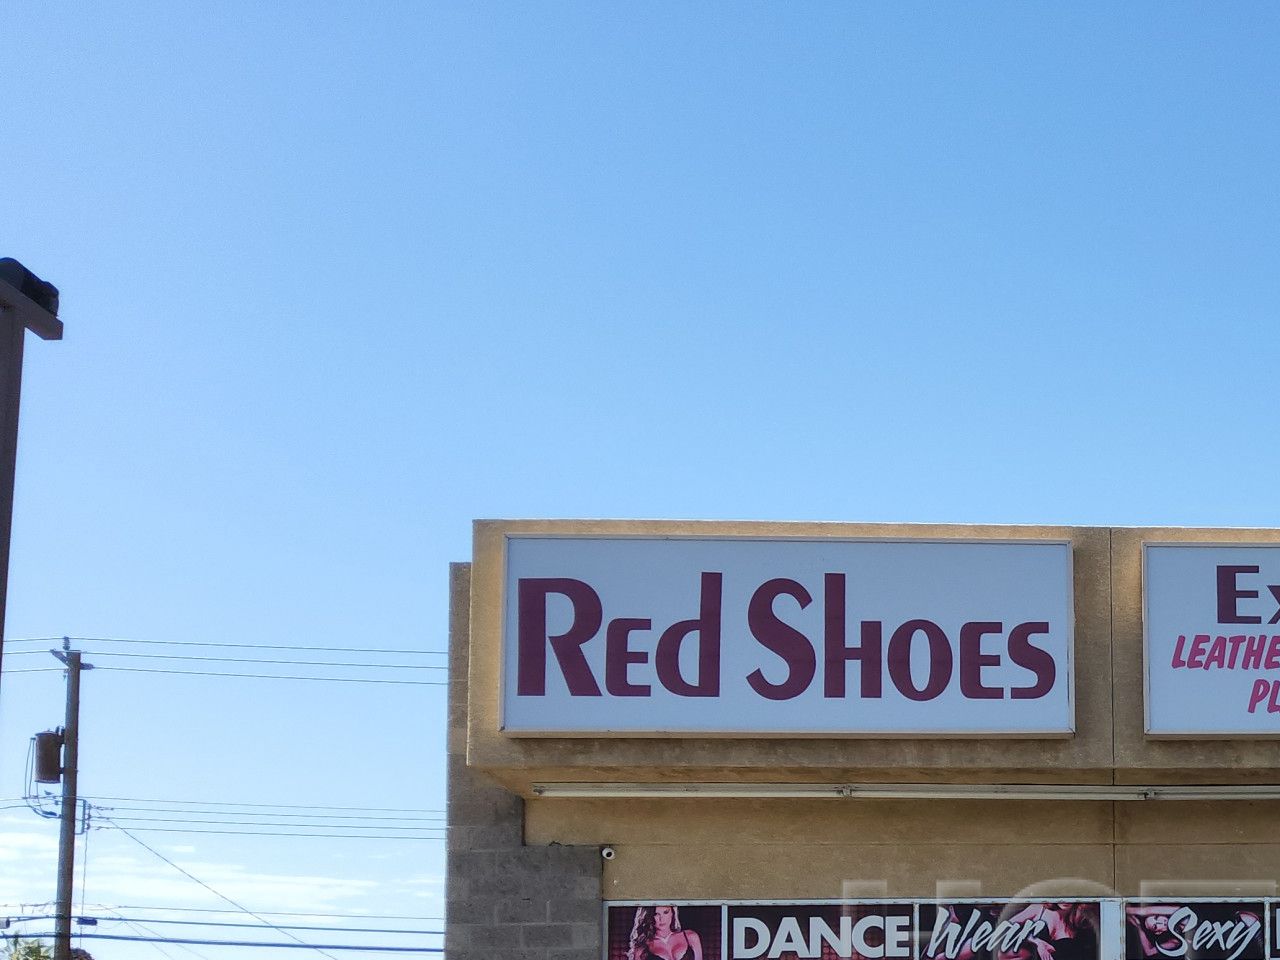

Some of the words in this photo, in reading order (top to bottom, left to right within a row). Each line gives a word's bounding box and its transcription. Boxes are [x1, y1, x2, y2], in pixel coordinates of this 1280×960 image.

[517, 572, 723, 697] Red
[745, 573, 1057, 701] Shoes
[732, 915, 910, 959] DANCE
[925, 907, 1051, 959] Wear
[1158, 906, 1263, 960] Sexy
